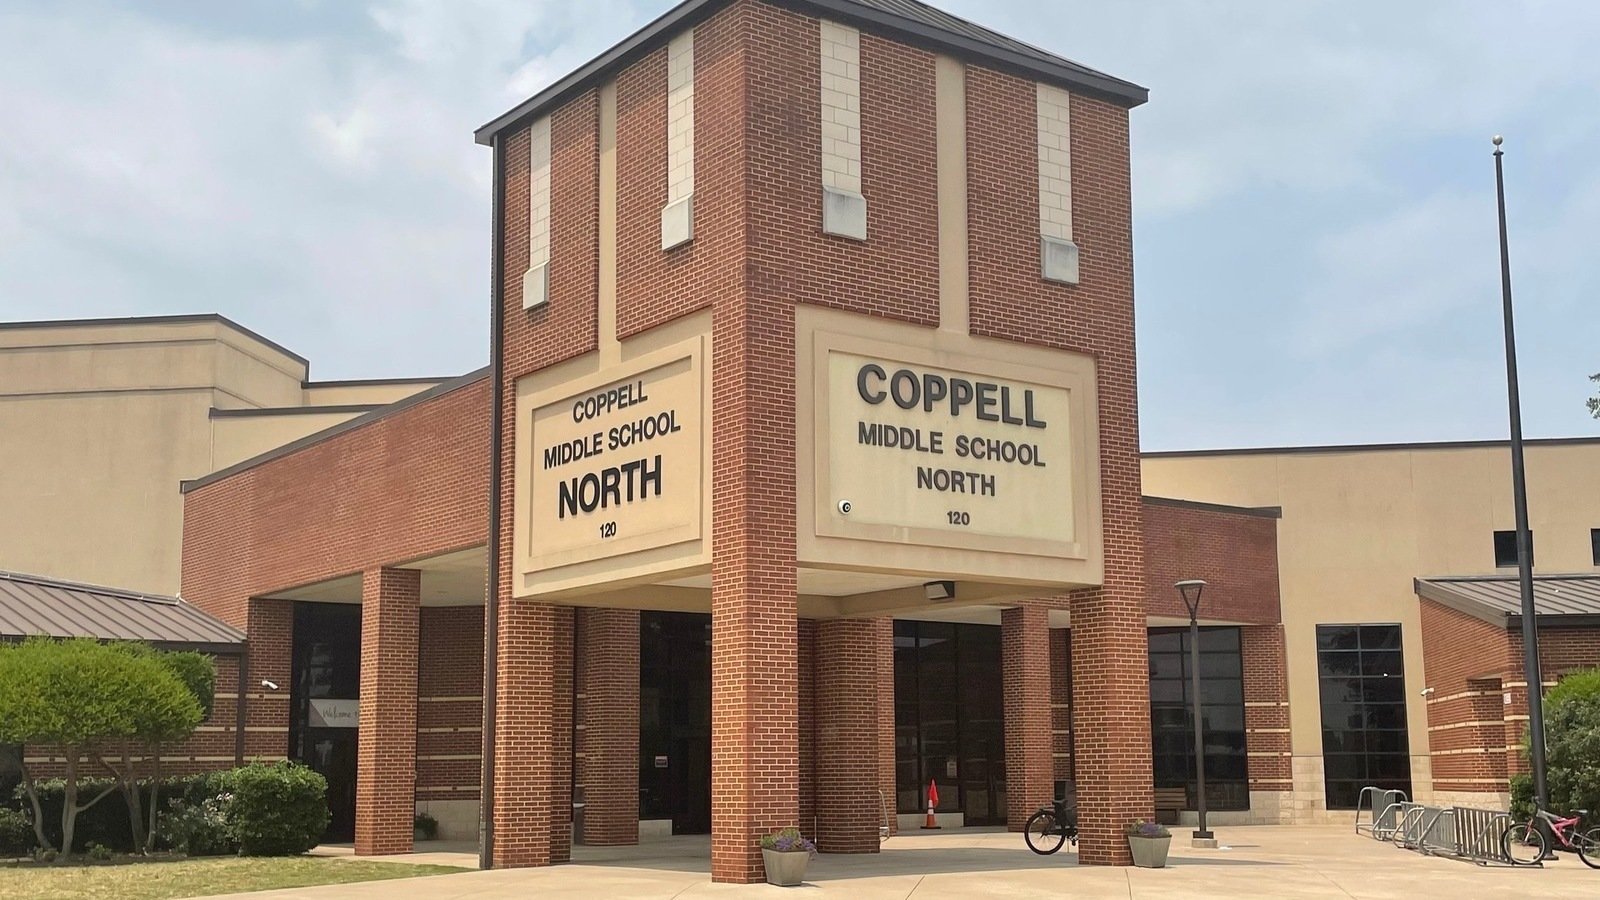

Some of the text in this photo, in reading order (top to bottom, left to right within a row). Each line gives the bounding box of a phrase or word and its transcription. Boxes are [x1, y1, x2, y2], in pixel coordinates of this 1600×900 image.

[573, 381, 648, 424] COPPELL
[857, 364, 1047, 429] COPPELL
[544, 410, 681, 470] MIDDLE SCHOOL
[858, 421, 1046, 467] MIDDLE SCHOOL
[559, 455, 662, 519] NORTH
[917, 467, 995, 497] NORTH
[600, 521, 617, 539] 120
[947, 511, 970, 526] 120
[322, 705, 351, 719] Welcome
